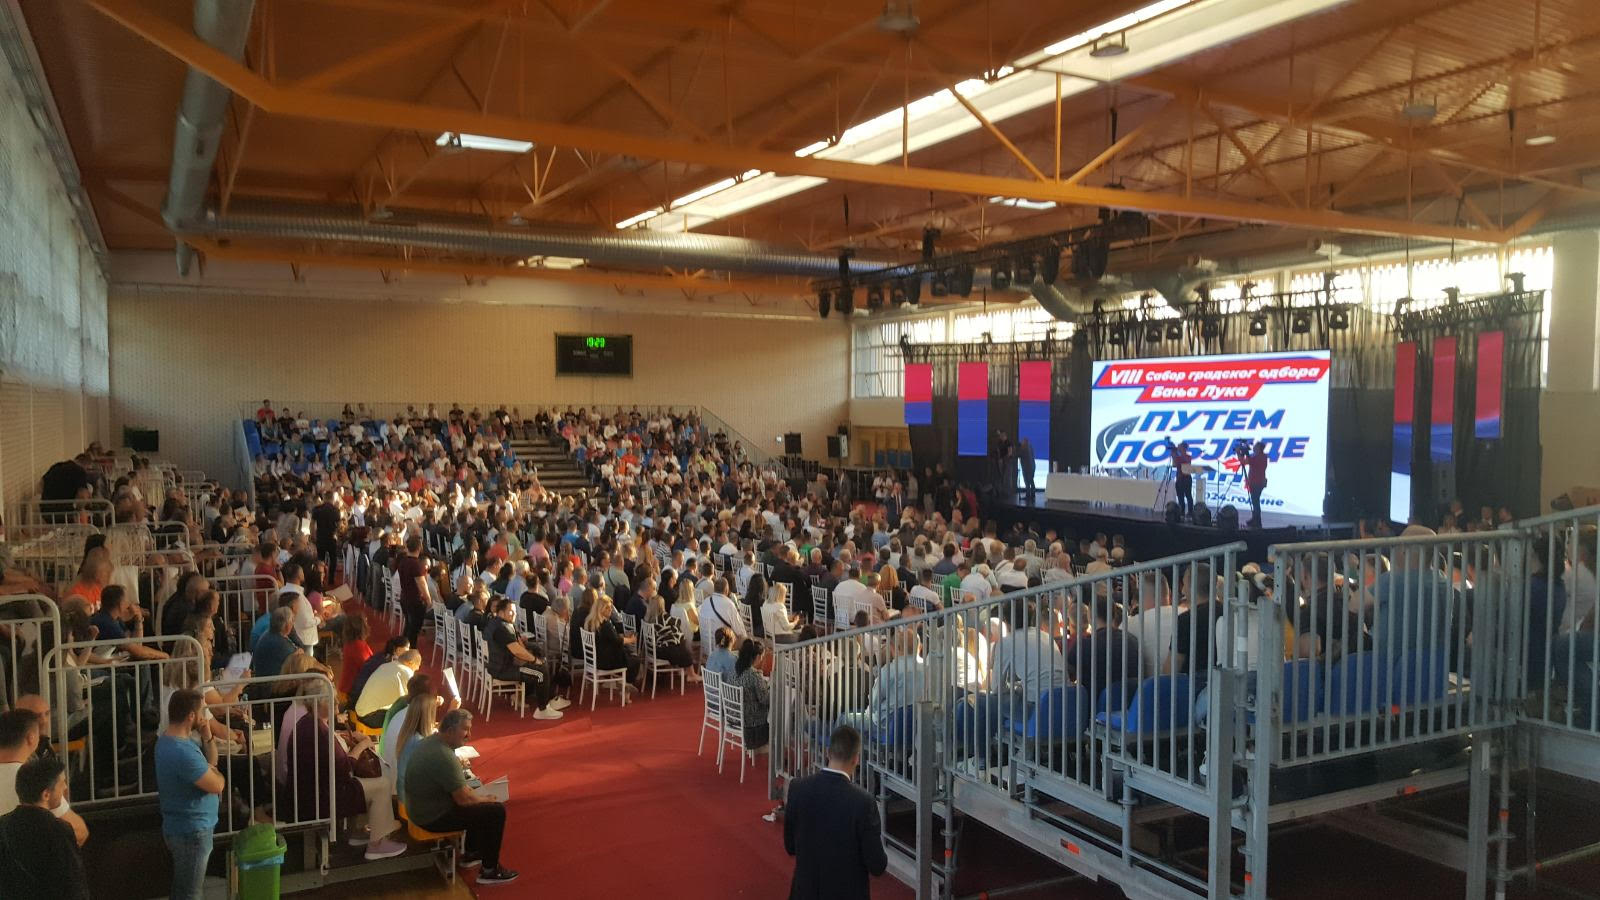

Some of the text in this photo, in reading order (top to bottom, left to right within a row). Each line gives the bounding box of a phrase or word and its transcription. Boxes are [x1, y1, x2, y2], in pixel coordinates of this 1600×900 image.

[1110, 366, 1320, 384] VIII Сабор градског одбора
[1151, 384, 1249, 400] Бања Лука
[1138, 409, 1286, 432] ПУТЕМ
